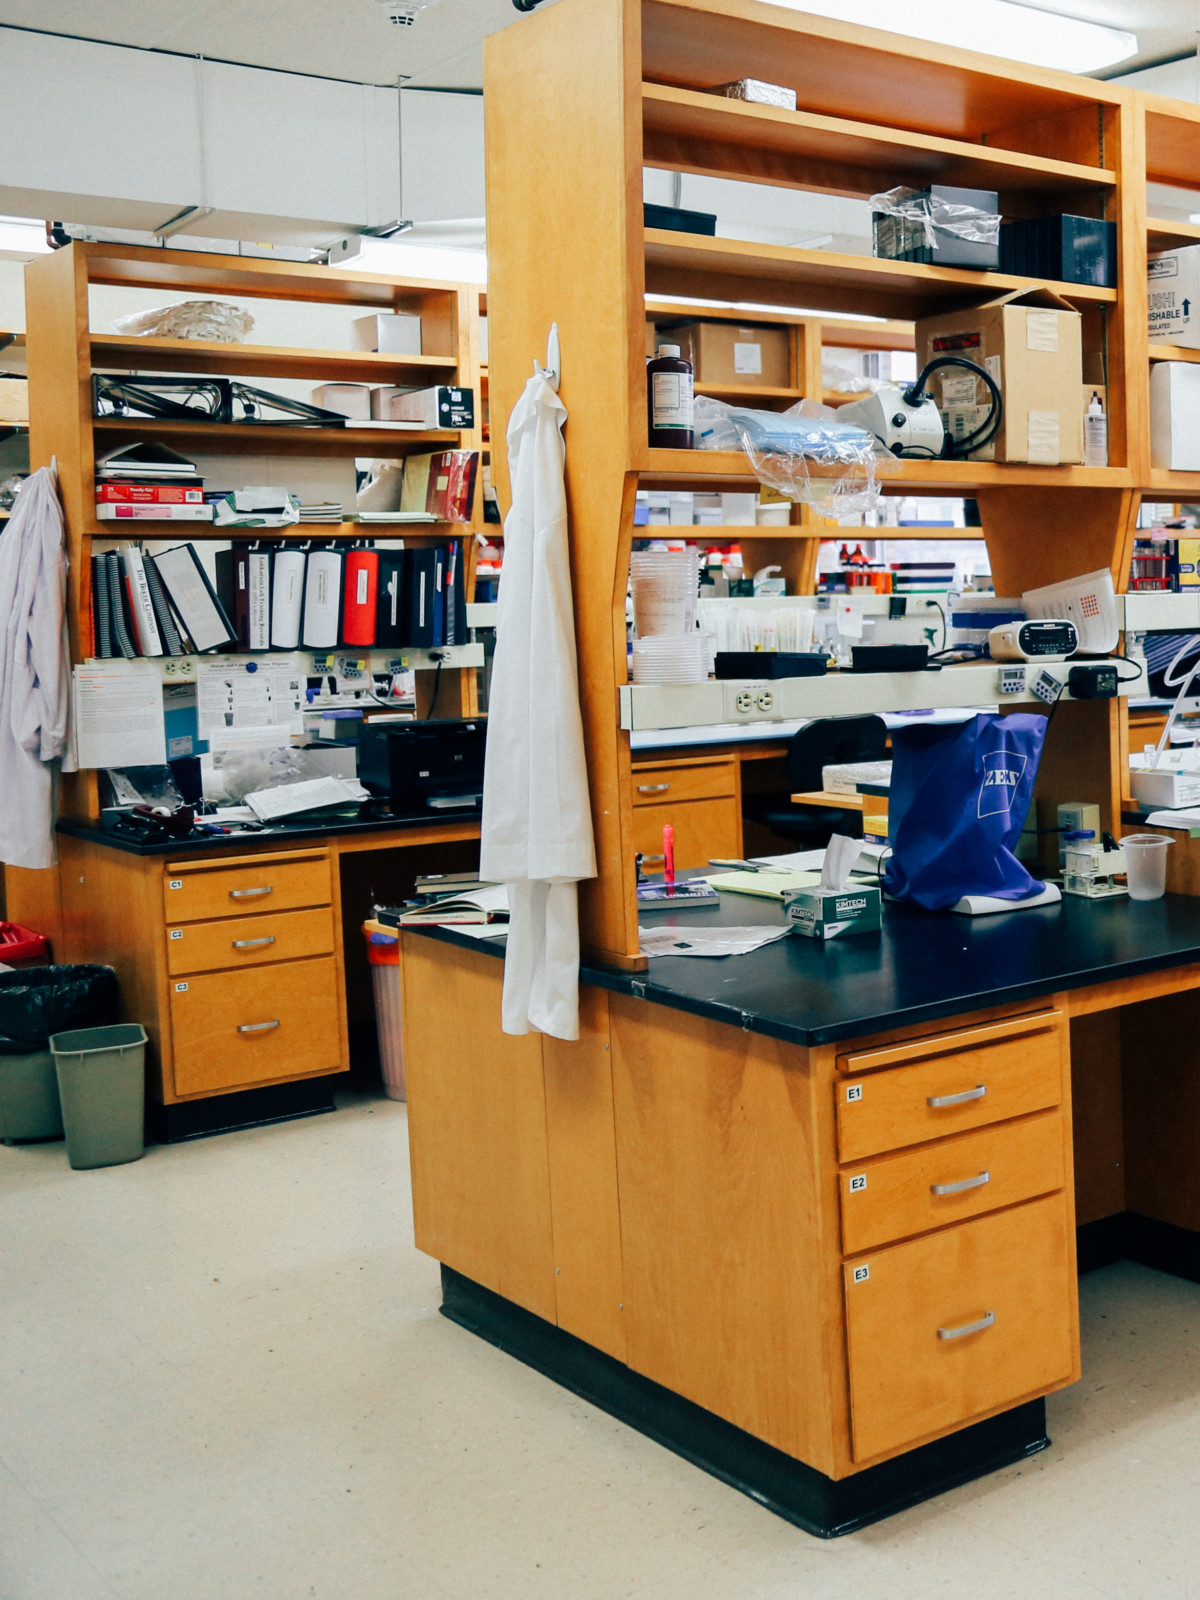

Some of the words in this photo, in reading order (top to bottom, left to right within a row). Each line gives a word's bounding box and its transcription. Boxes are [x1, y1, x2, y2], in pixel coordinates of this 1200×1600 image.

[836, 898, 867, 908] KIMTECH
[791, 908, 815, 918] KIMTECH
[177, 983, 187, 991] C3
[848, 1087, 861, 1099] E1
[852, 1177, 865, 1190] E2
[855, 1268, 868, 1281] E3
